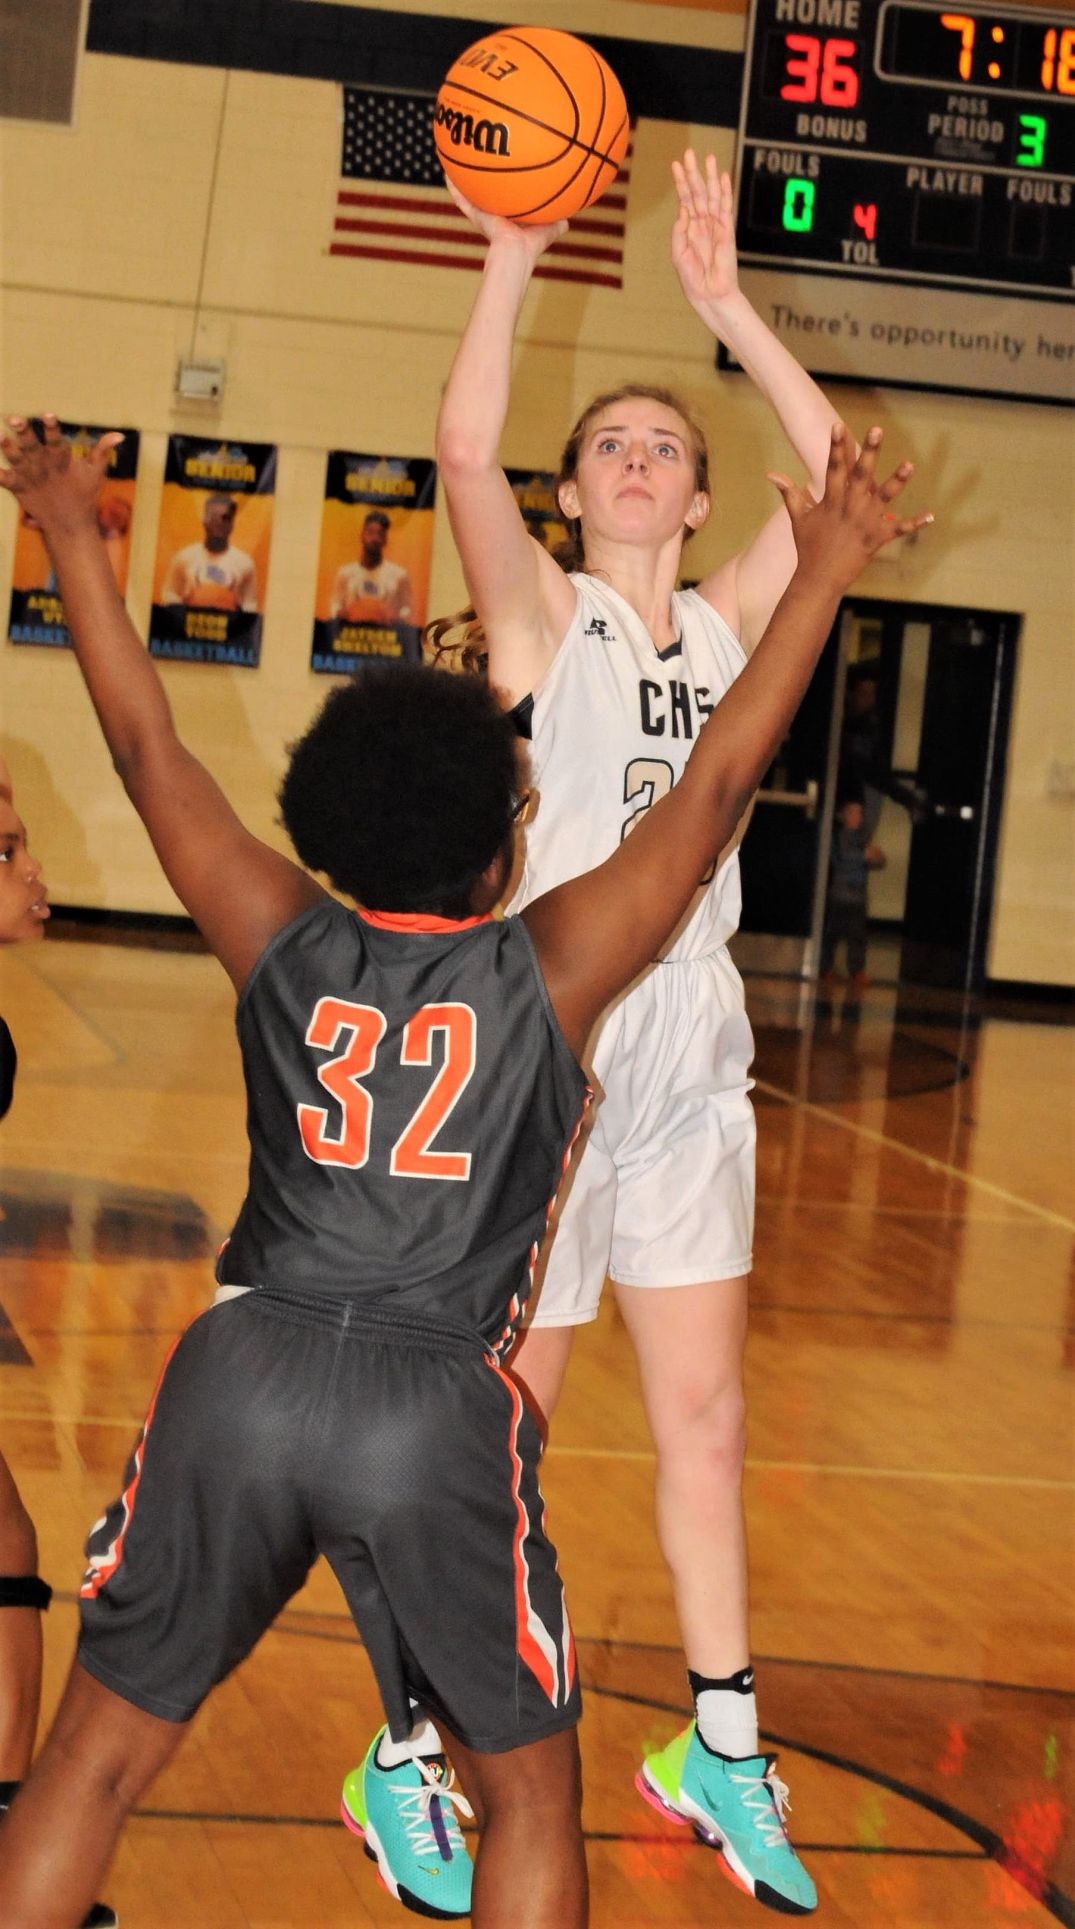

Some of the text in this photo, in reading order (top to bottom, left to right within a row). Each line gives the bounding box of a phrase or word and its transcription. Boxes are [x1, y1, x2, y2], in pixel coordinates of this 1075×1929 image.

[775, 0, 861, 29] HOME
[780, 34, 859, 108] 36
[947, 96, 988, 115] POSS
[797, 113, 867, 142] BONUS
[928, 113, 1004, 143] PERIOD
[1016, 114, 1046, 167] 3
[754, 148, 820, 177] FOULS
[906, 167, 984, 196] PLAYER
[1006, 178, 1072, 206] FOULS
[783, 178, 815, 232] 0
[853, 204, 877, 241] 4
[842, 240, 879, 267] TOL
[770, 303, 859, 339] There's
[870, 320, 1025, 363] opportunity
[185, 457, 256, 482] SENIOR
[345, 472, 416, 496] SENIOR
[151, 638, 257, 666] BASKETBALL
[639, 678, 714, 739] CHS
[297, 996, 477, 1180] 32
